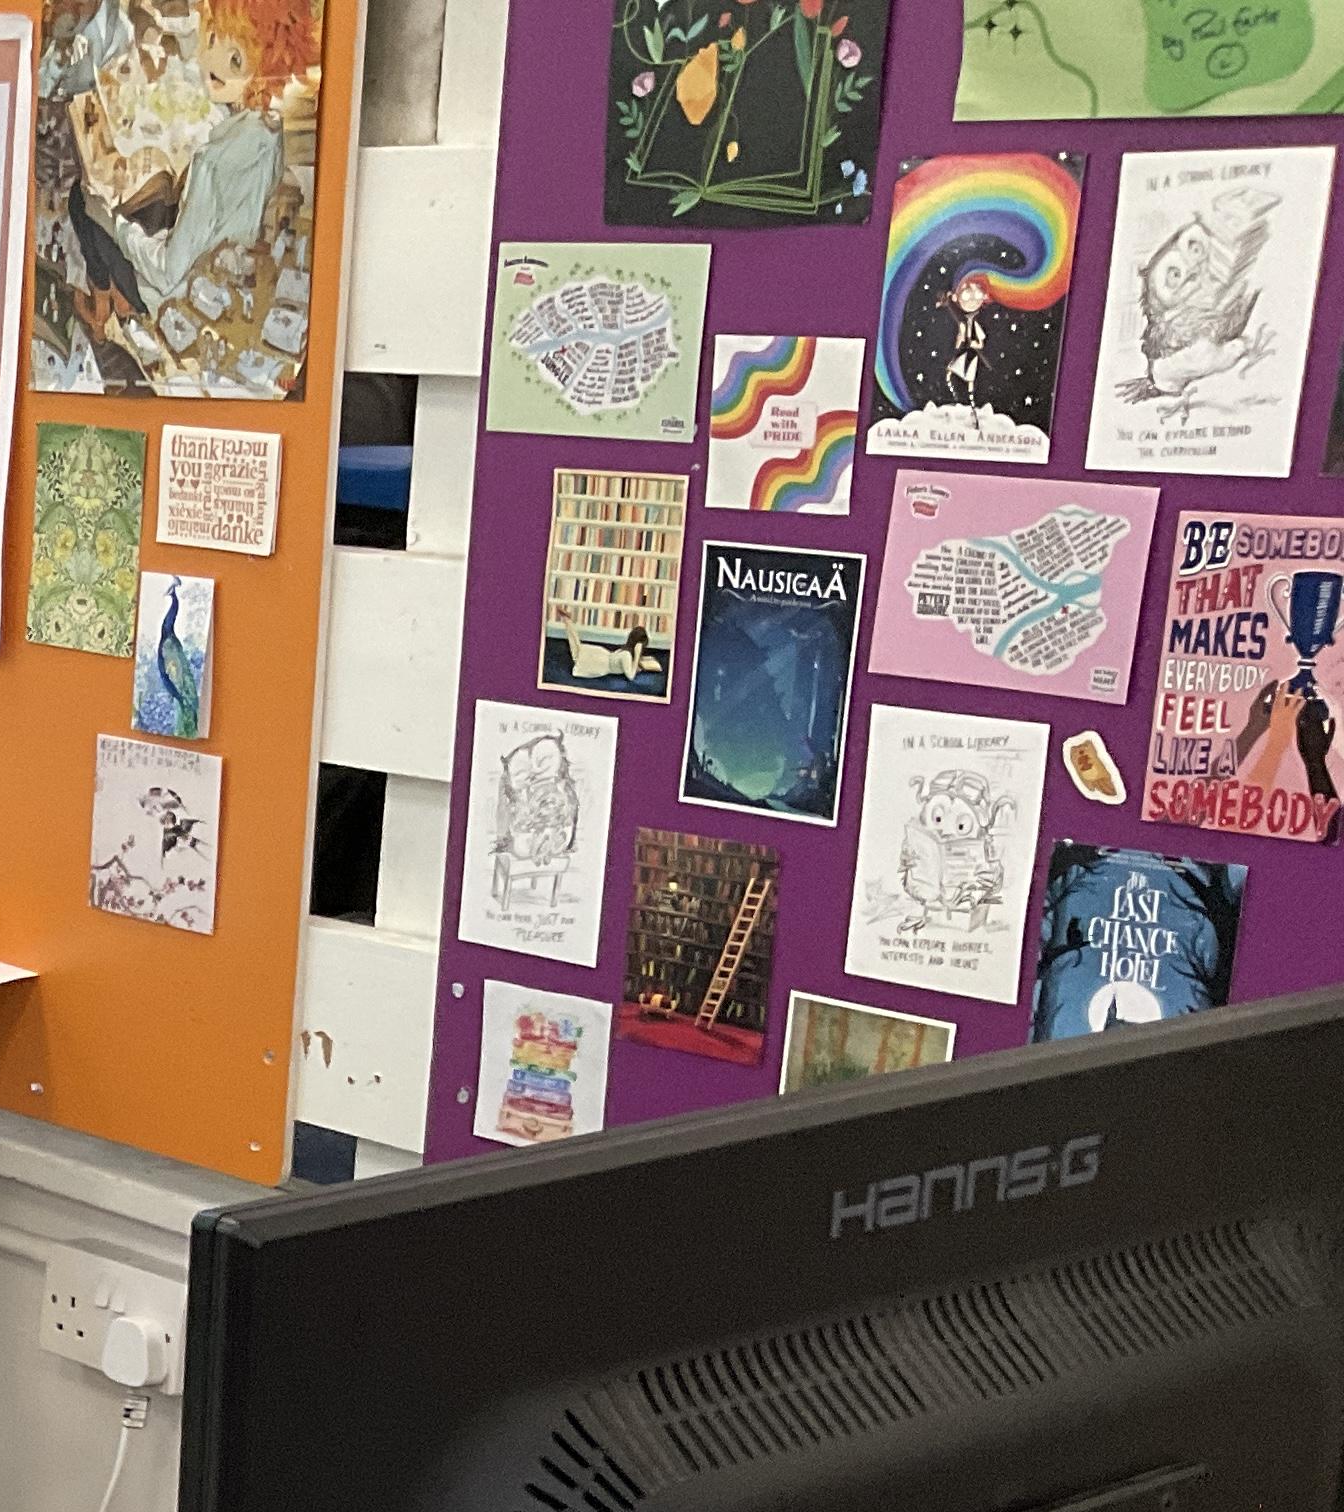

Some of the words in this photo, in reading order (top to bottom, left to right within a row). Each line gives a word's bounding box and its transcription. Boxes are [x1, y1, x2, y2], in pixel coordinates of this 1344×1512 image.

[771, 407, 800, 418] Read
[771, 420, 798, 430] with
[172, 434, 218, 461] thank
[763, 431, 801, 441] PRIDE
[170, 460, 201, 482] you
[212, 516, 264, 545] danke
[1179, 520, 1236, 575] BE
[1236, 523, 1344, 561] SOMEBO
[1174, 563, 1264, 615] THAT
[1168, 612, 1270, 660] MAKES
[1163, 659, 1270, 693] EVERYBODY
[1157, 693, 1231, 735] FEEL
[1152, 733, 1212, 775] LIKE
[1218, 738, 1238, 776] A
[1148, 779, 1340, 839] SOMEBODY
[1111, 886, 1167, 924] LAST
[1088, 917, 1178, 957] CHANCE
[1100, 950, 1166, 991] HOTEL
